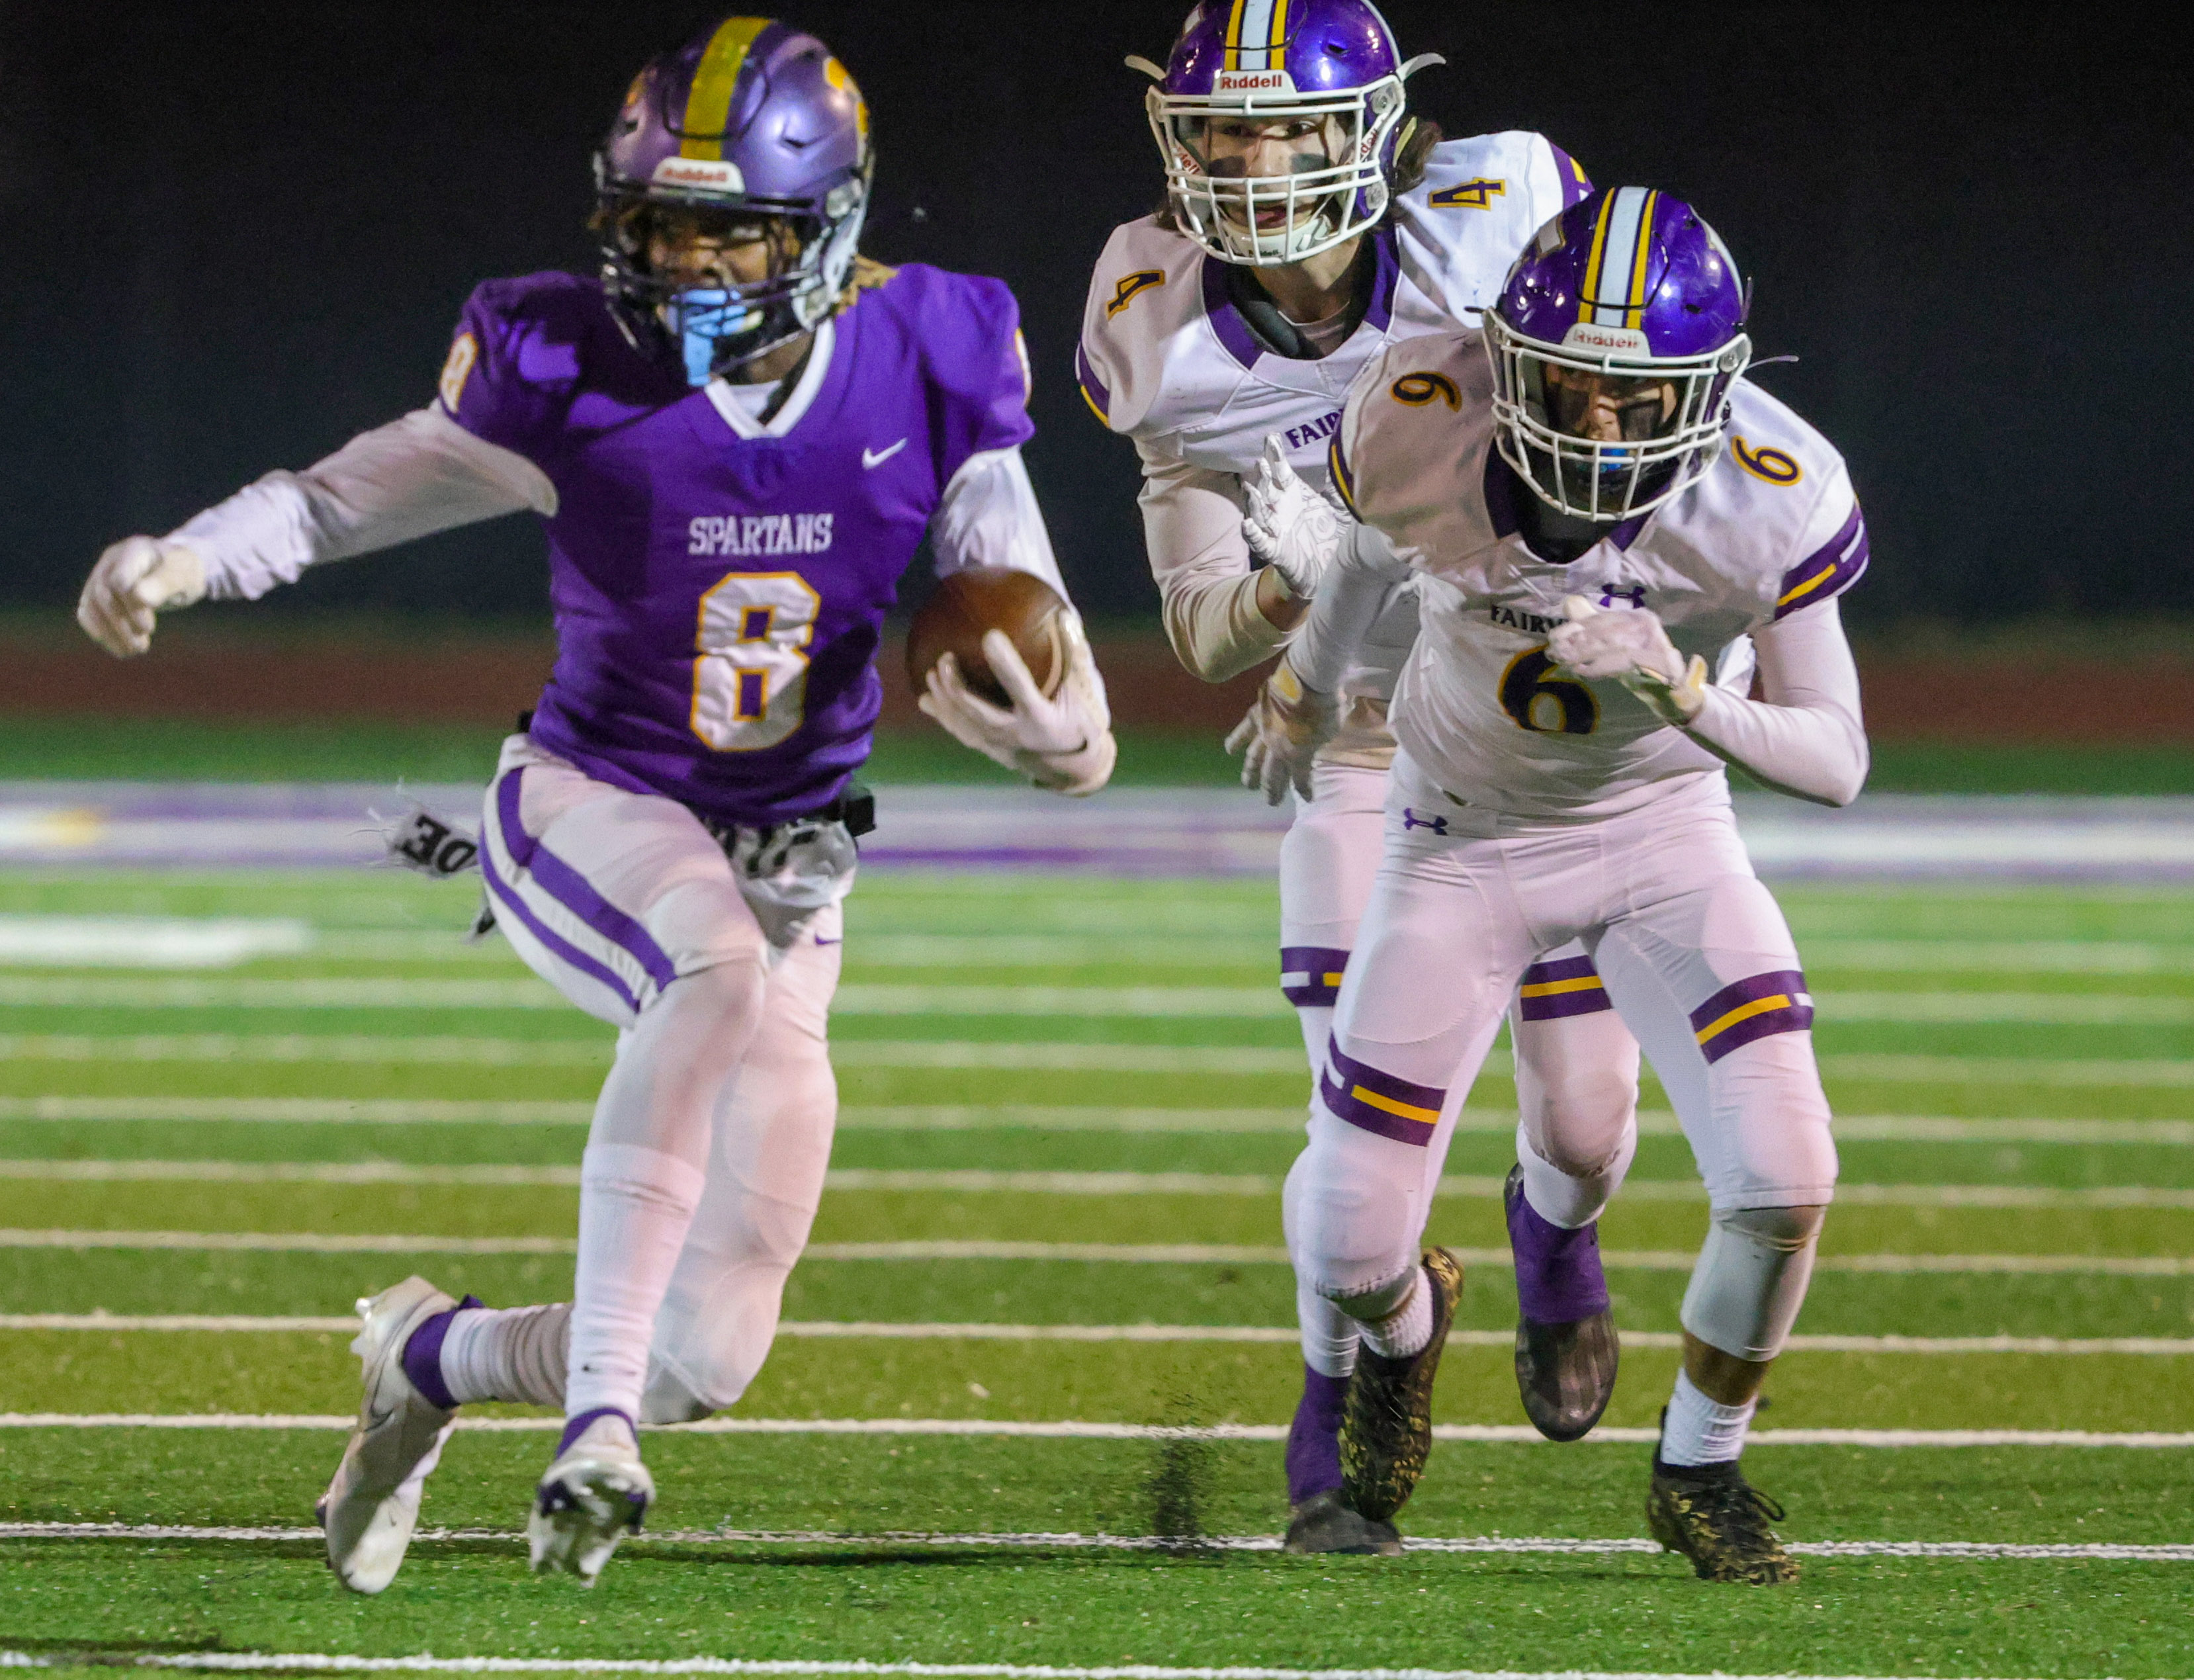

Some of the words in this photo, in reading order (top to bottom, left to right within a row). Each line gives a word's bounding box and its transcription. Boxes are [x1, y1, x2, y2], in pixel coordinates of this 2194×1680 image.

[1221, 75, 1282, 90] Riddell
[1428, 177, 1505, 210] 4
[1106, 269, 1165, 322] 4
[1573, 328, 1640, 349] Riddell
[1390, 371, 1462, 413] 6
[1731, 435, 1803, 487] 6
[687, 513, 834, 556] SPARTANS
[690, 570, 821, 752] 8
[1497, 643, 1601, 734] 6
